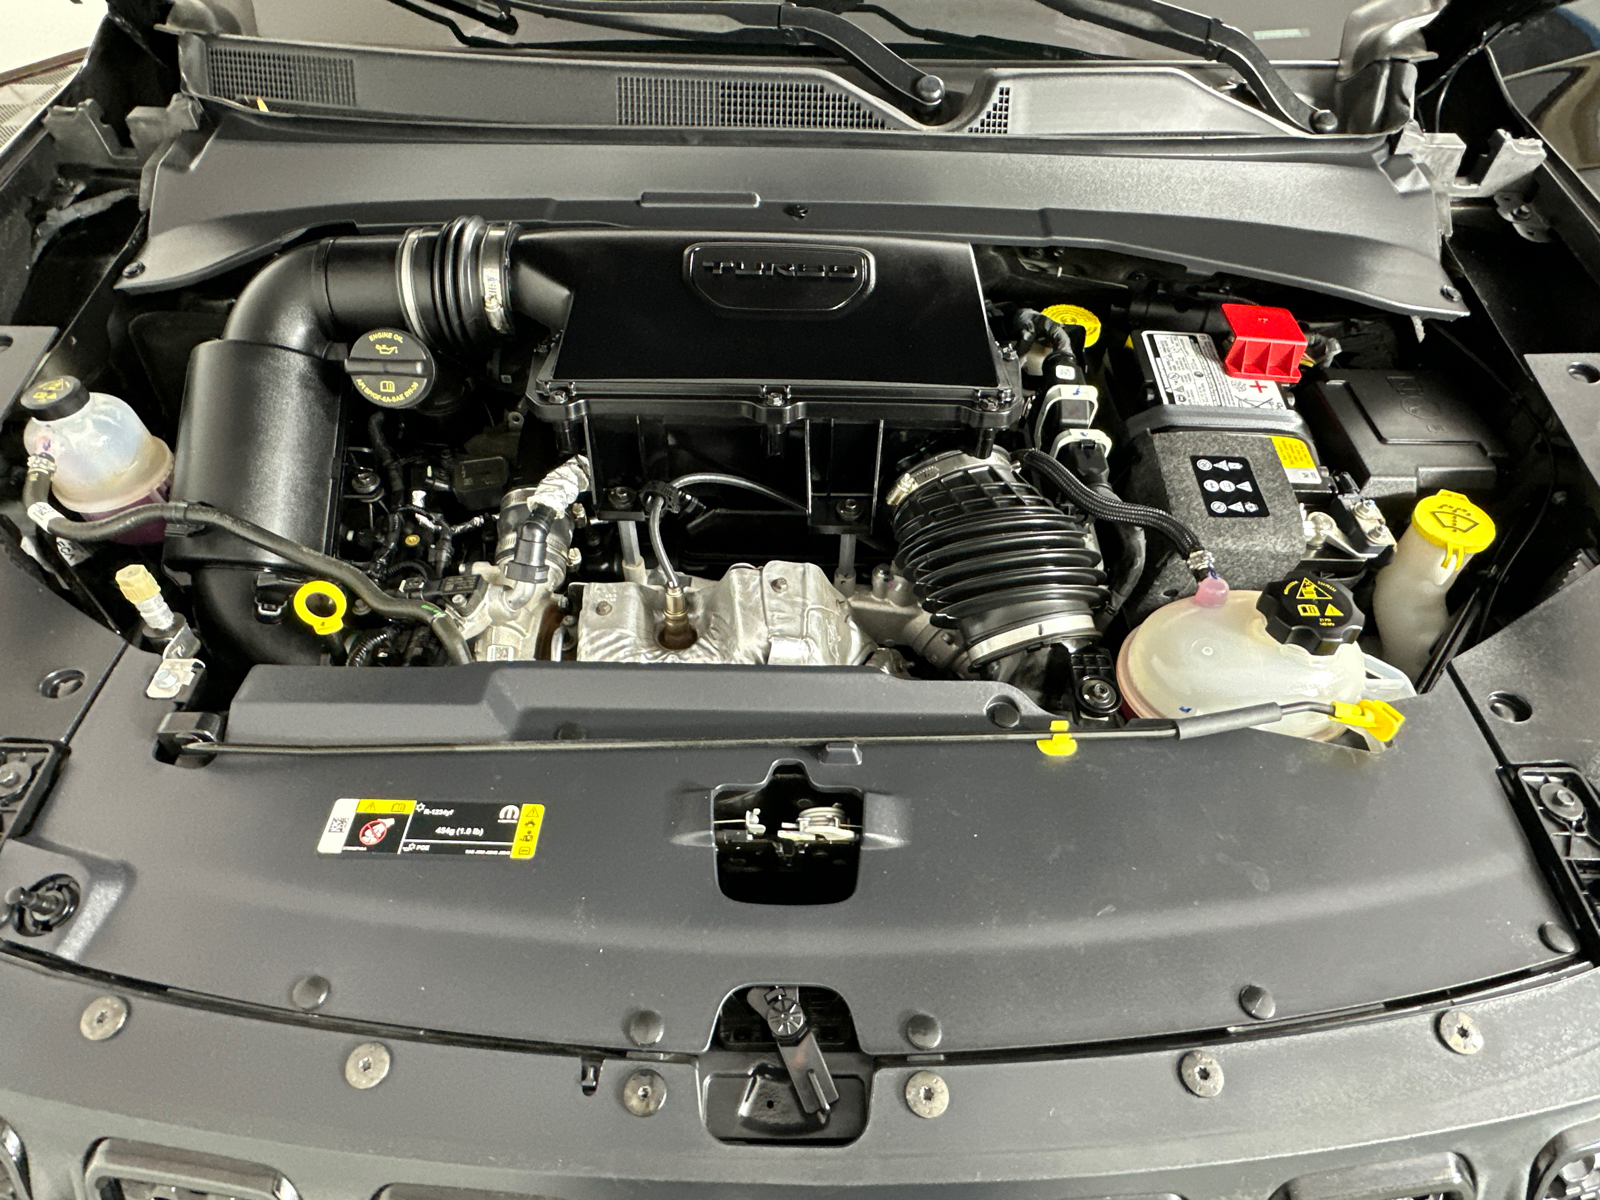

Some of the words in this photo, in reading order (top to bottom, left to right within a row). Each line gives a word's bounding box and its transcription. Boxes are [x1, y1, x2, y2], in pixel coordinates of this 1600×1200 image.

[702, 261, 858, 279] TURBO
[368, 331, 392, 342] ENGINE
[393, 333, 404, 344] OIL
[356, 378, 365, 391] API
[423, 808, 454, 817] R-1234yf
[435, 826, 456, 836] 454g
[456, 826, 472, 836] (1.0
[472, 827, 484, 836] lb)
